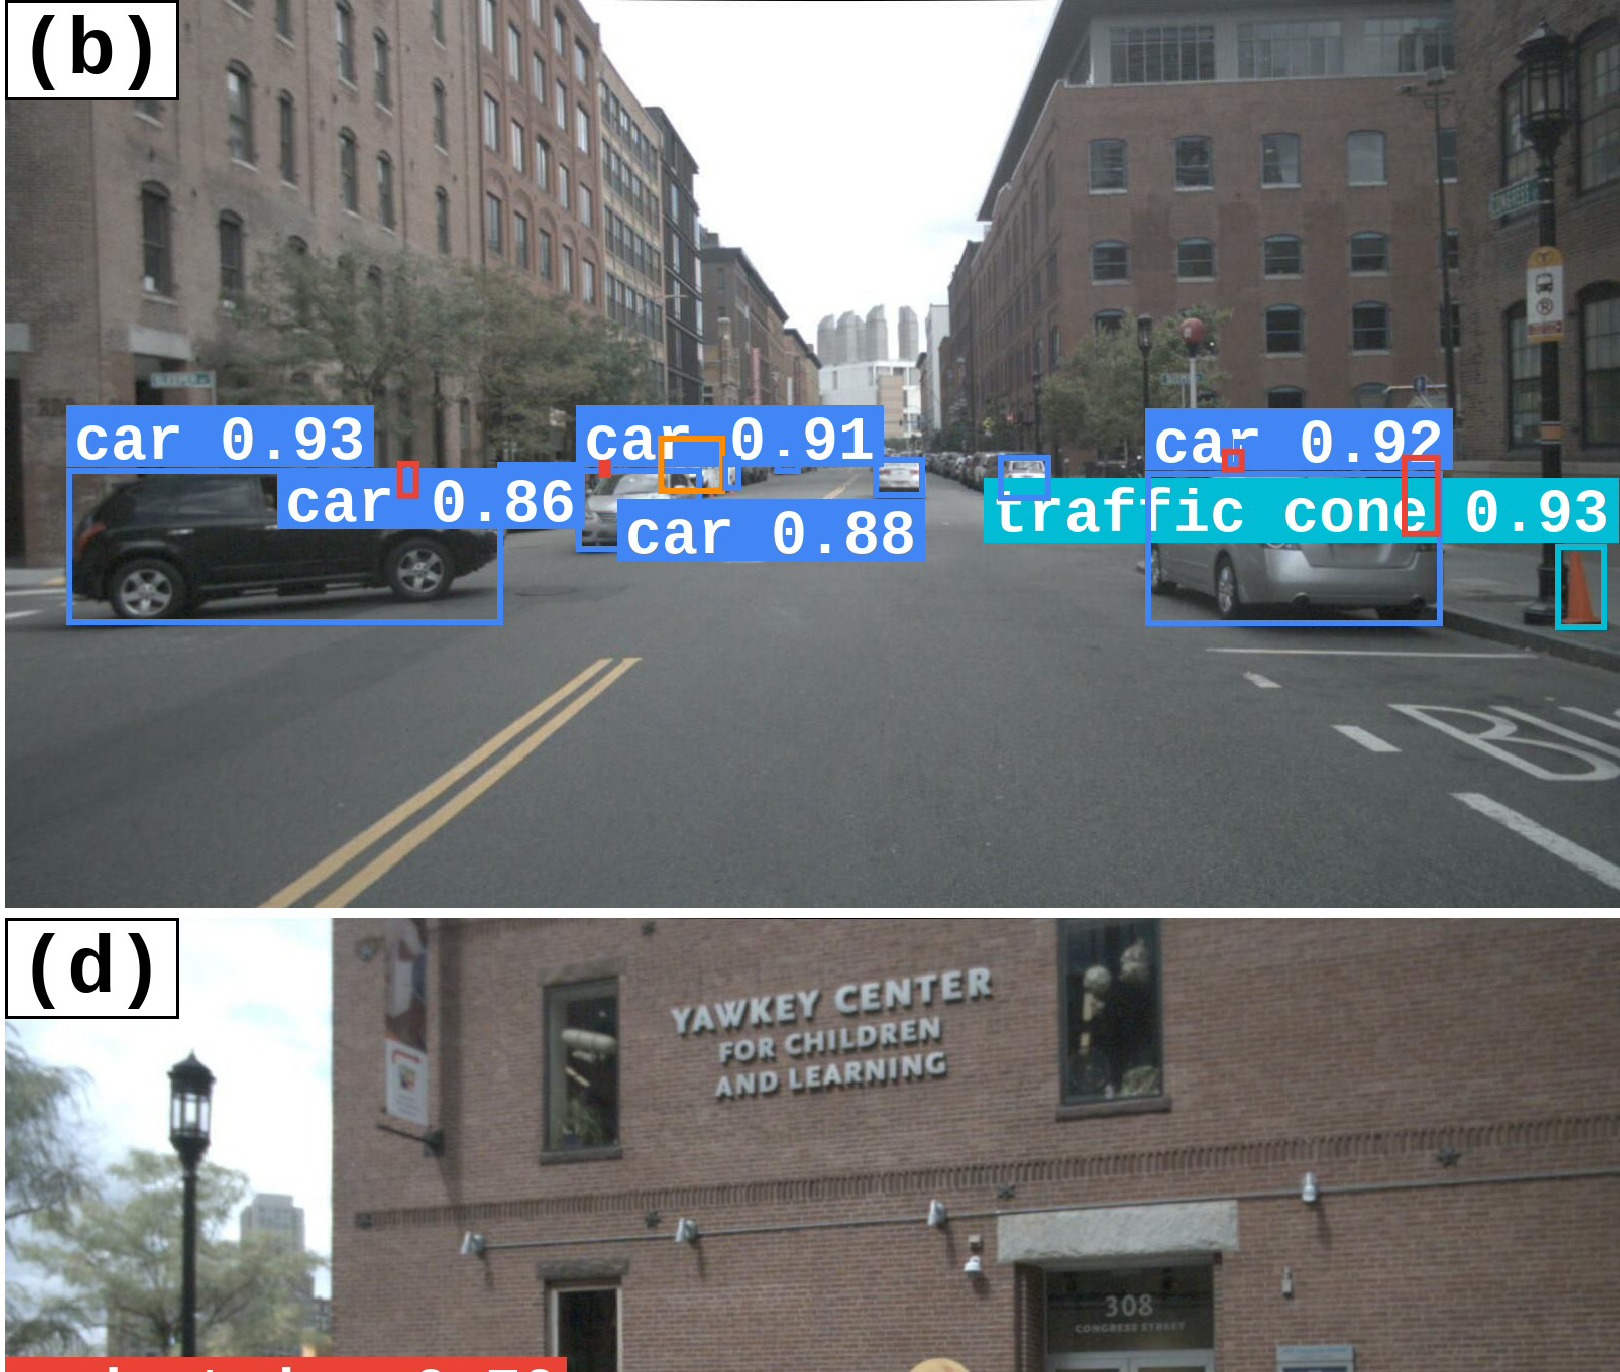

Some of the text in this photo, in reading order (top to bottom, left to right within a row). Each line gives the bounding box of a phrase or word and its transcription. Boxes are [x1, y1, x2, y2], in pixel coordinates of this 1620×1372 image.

[1387, 704, 1620, 782] BU
[671, 967, 993, 1036] YAWKEY CENTER
[718, 1016, 943, 1066] FOR CHILDREN
[713, 1050, 949, 1101] AND LEARNING
[1074, 1321, 1186, 1334] CONGRESS STREET
[1105, 1293, 1154, 1318] 308
